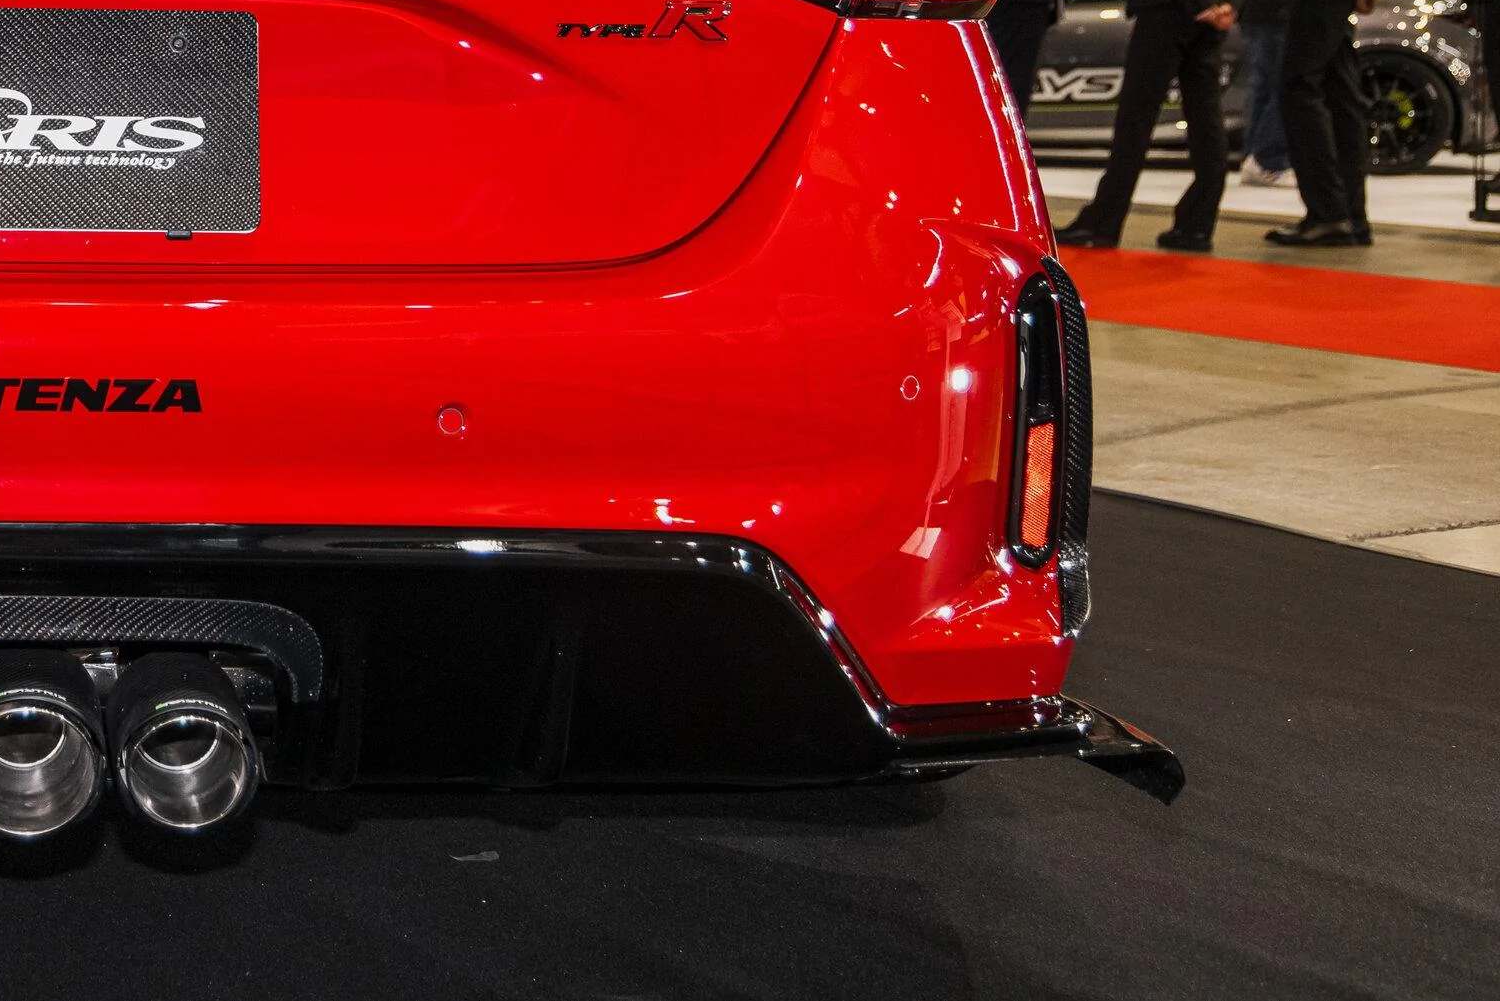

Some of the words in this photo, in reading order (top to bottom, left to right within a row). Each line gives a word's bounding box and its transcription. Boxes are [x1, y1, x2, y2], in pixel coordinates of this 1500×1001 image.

[556, 23, 647, 38] TYPE
[647, 0, 731, 41] R
[1030, 66, 1125, 102] YS
[24, 151, 82, 168] future
[84, 152, 176, 170] technology
